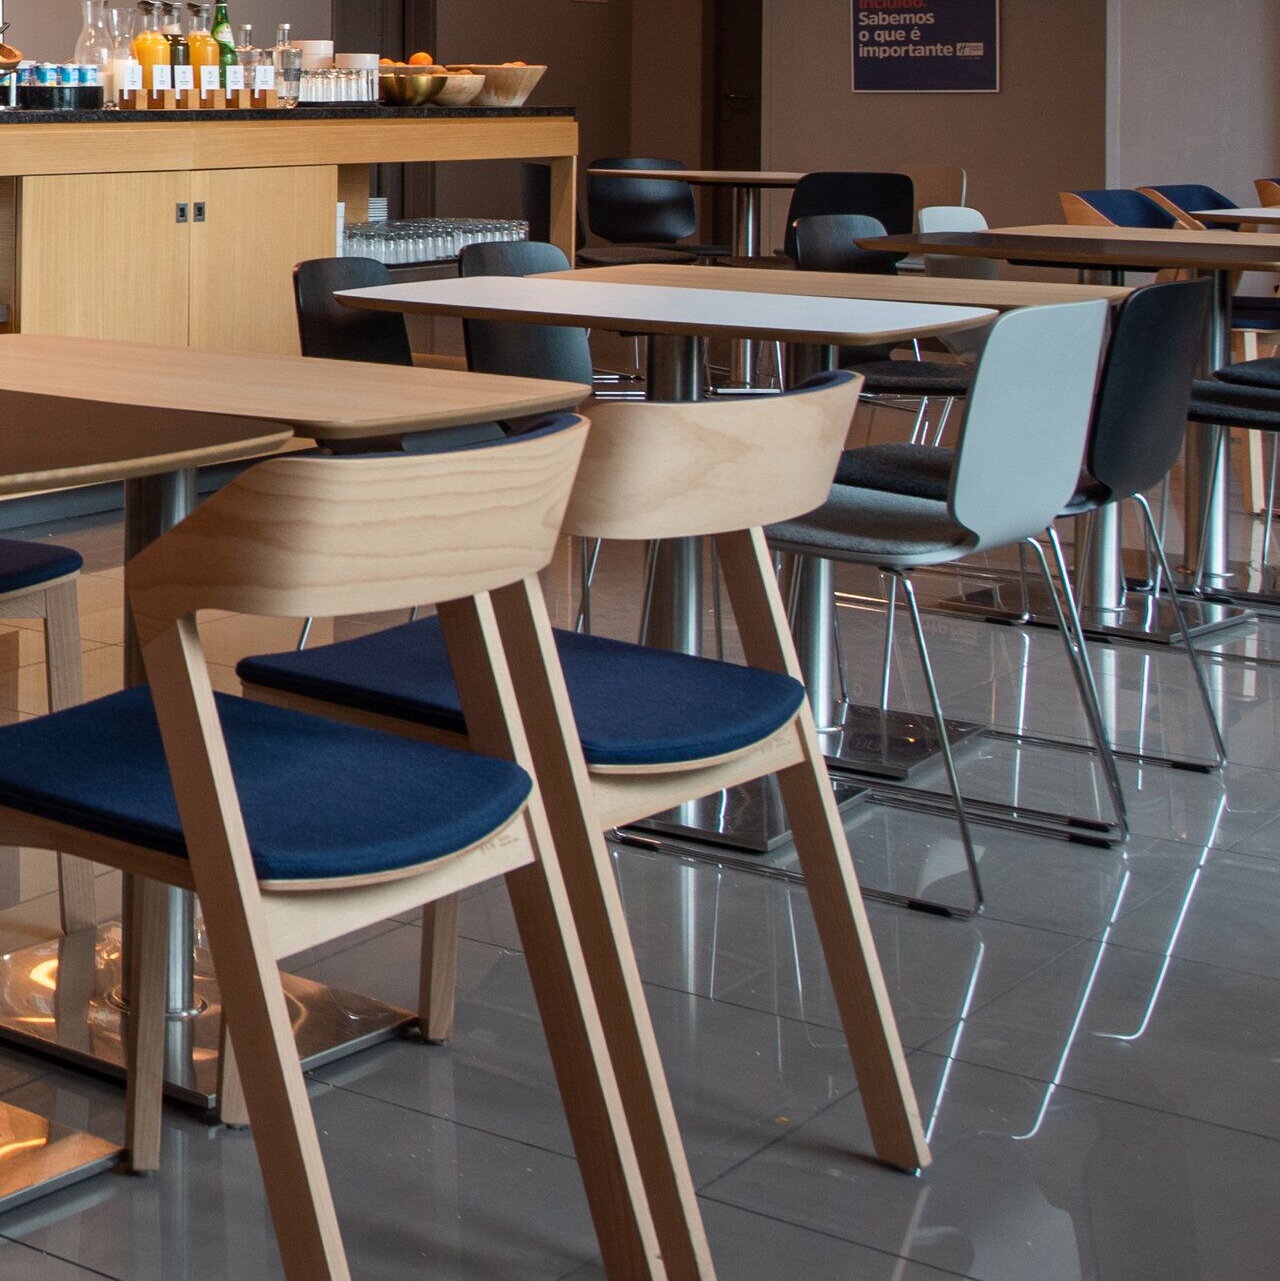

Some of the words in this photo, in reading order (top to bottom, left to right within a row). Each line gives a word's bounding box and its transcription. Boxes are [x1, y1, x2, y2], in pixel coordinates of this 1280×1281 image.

[858, 12, 935, 25] Sabemos
[858, 30, 869, 41] o
[873, 29, 906, 42] que
[910, 26, 921, 40] é
[859, 43, 953, 58] importante
